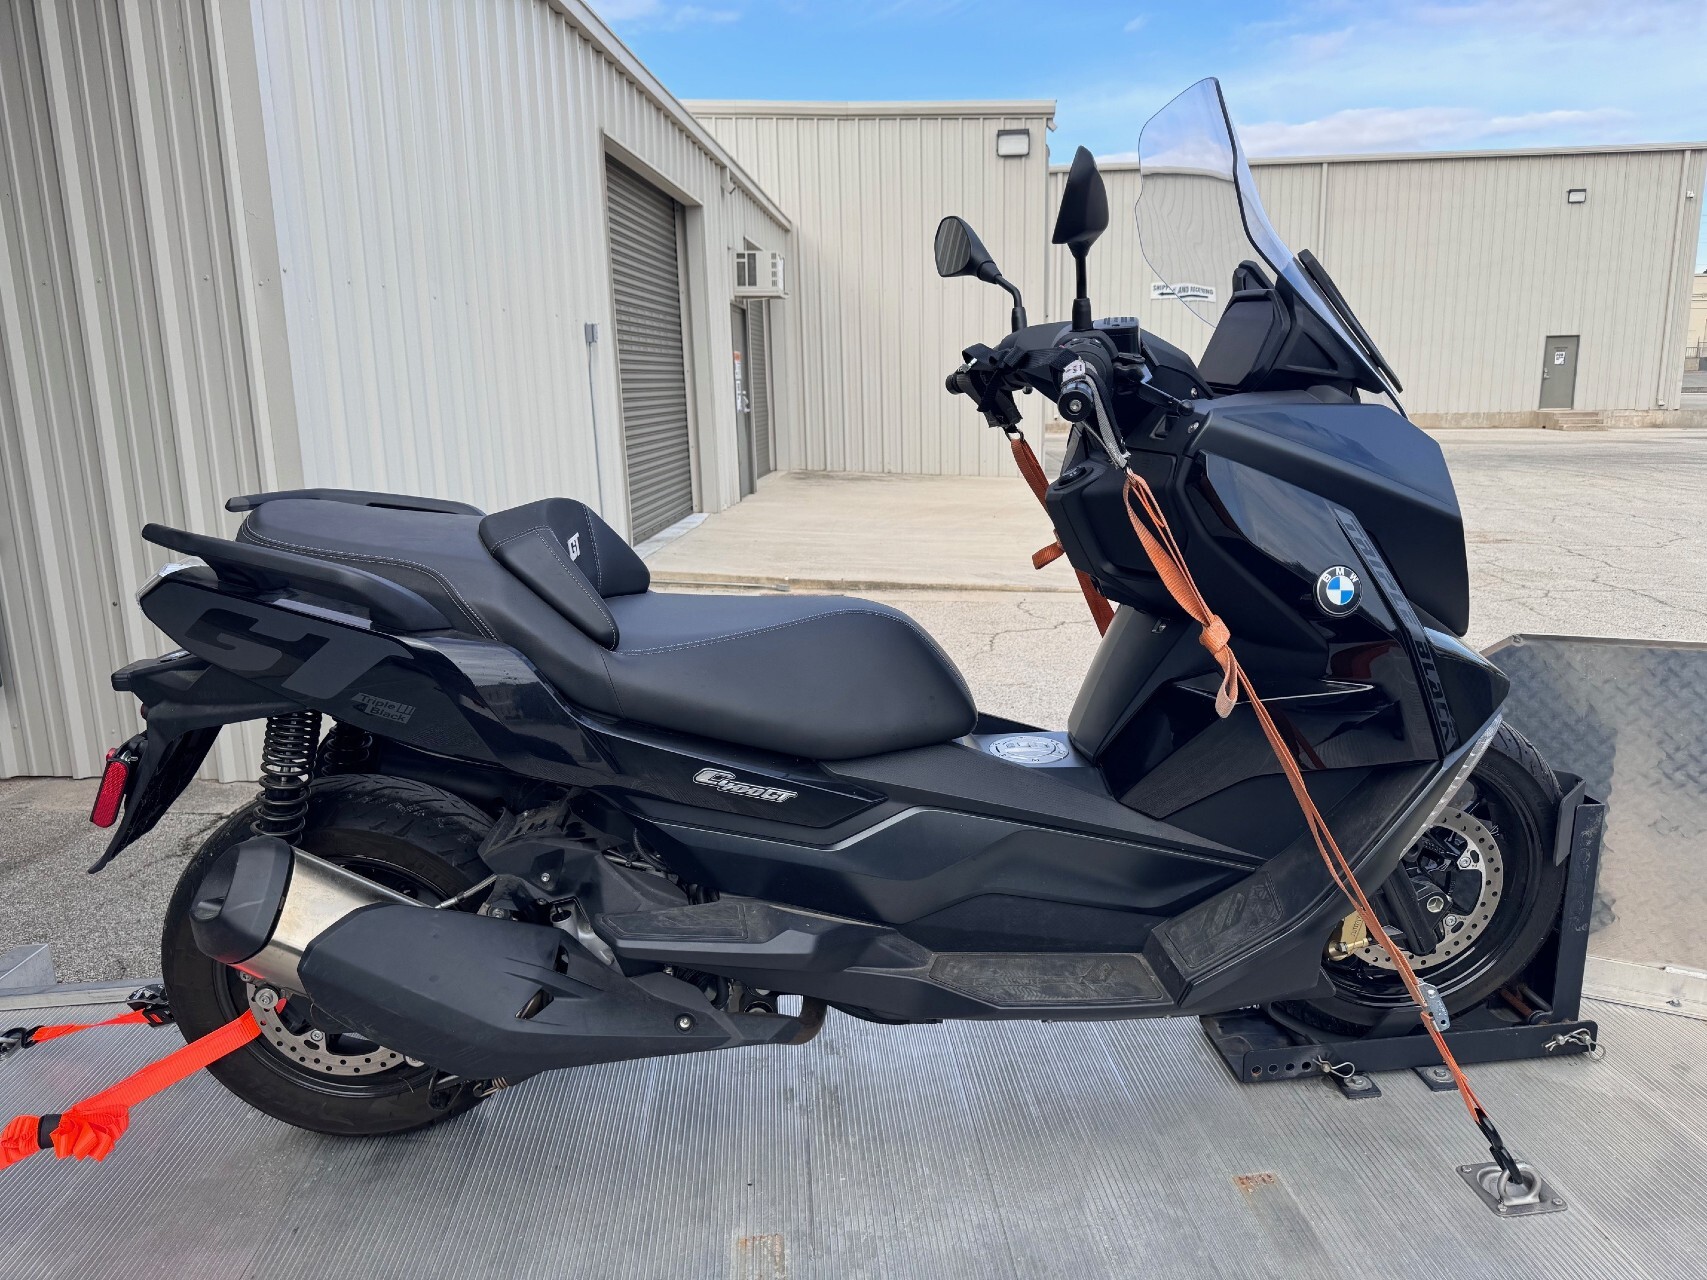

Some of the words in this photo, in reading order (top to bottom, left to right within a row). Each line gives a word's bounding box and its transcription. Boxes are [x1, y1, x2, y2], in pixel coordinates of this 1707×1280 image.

[1343, 516, 1418, 626] TRIPLE
[1416, 639, 1457, 741] BLACK
[361, 694, 396, 709] Triple
[371, 706, 407, 721] Black
